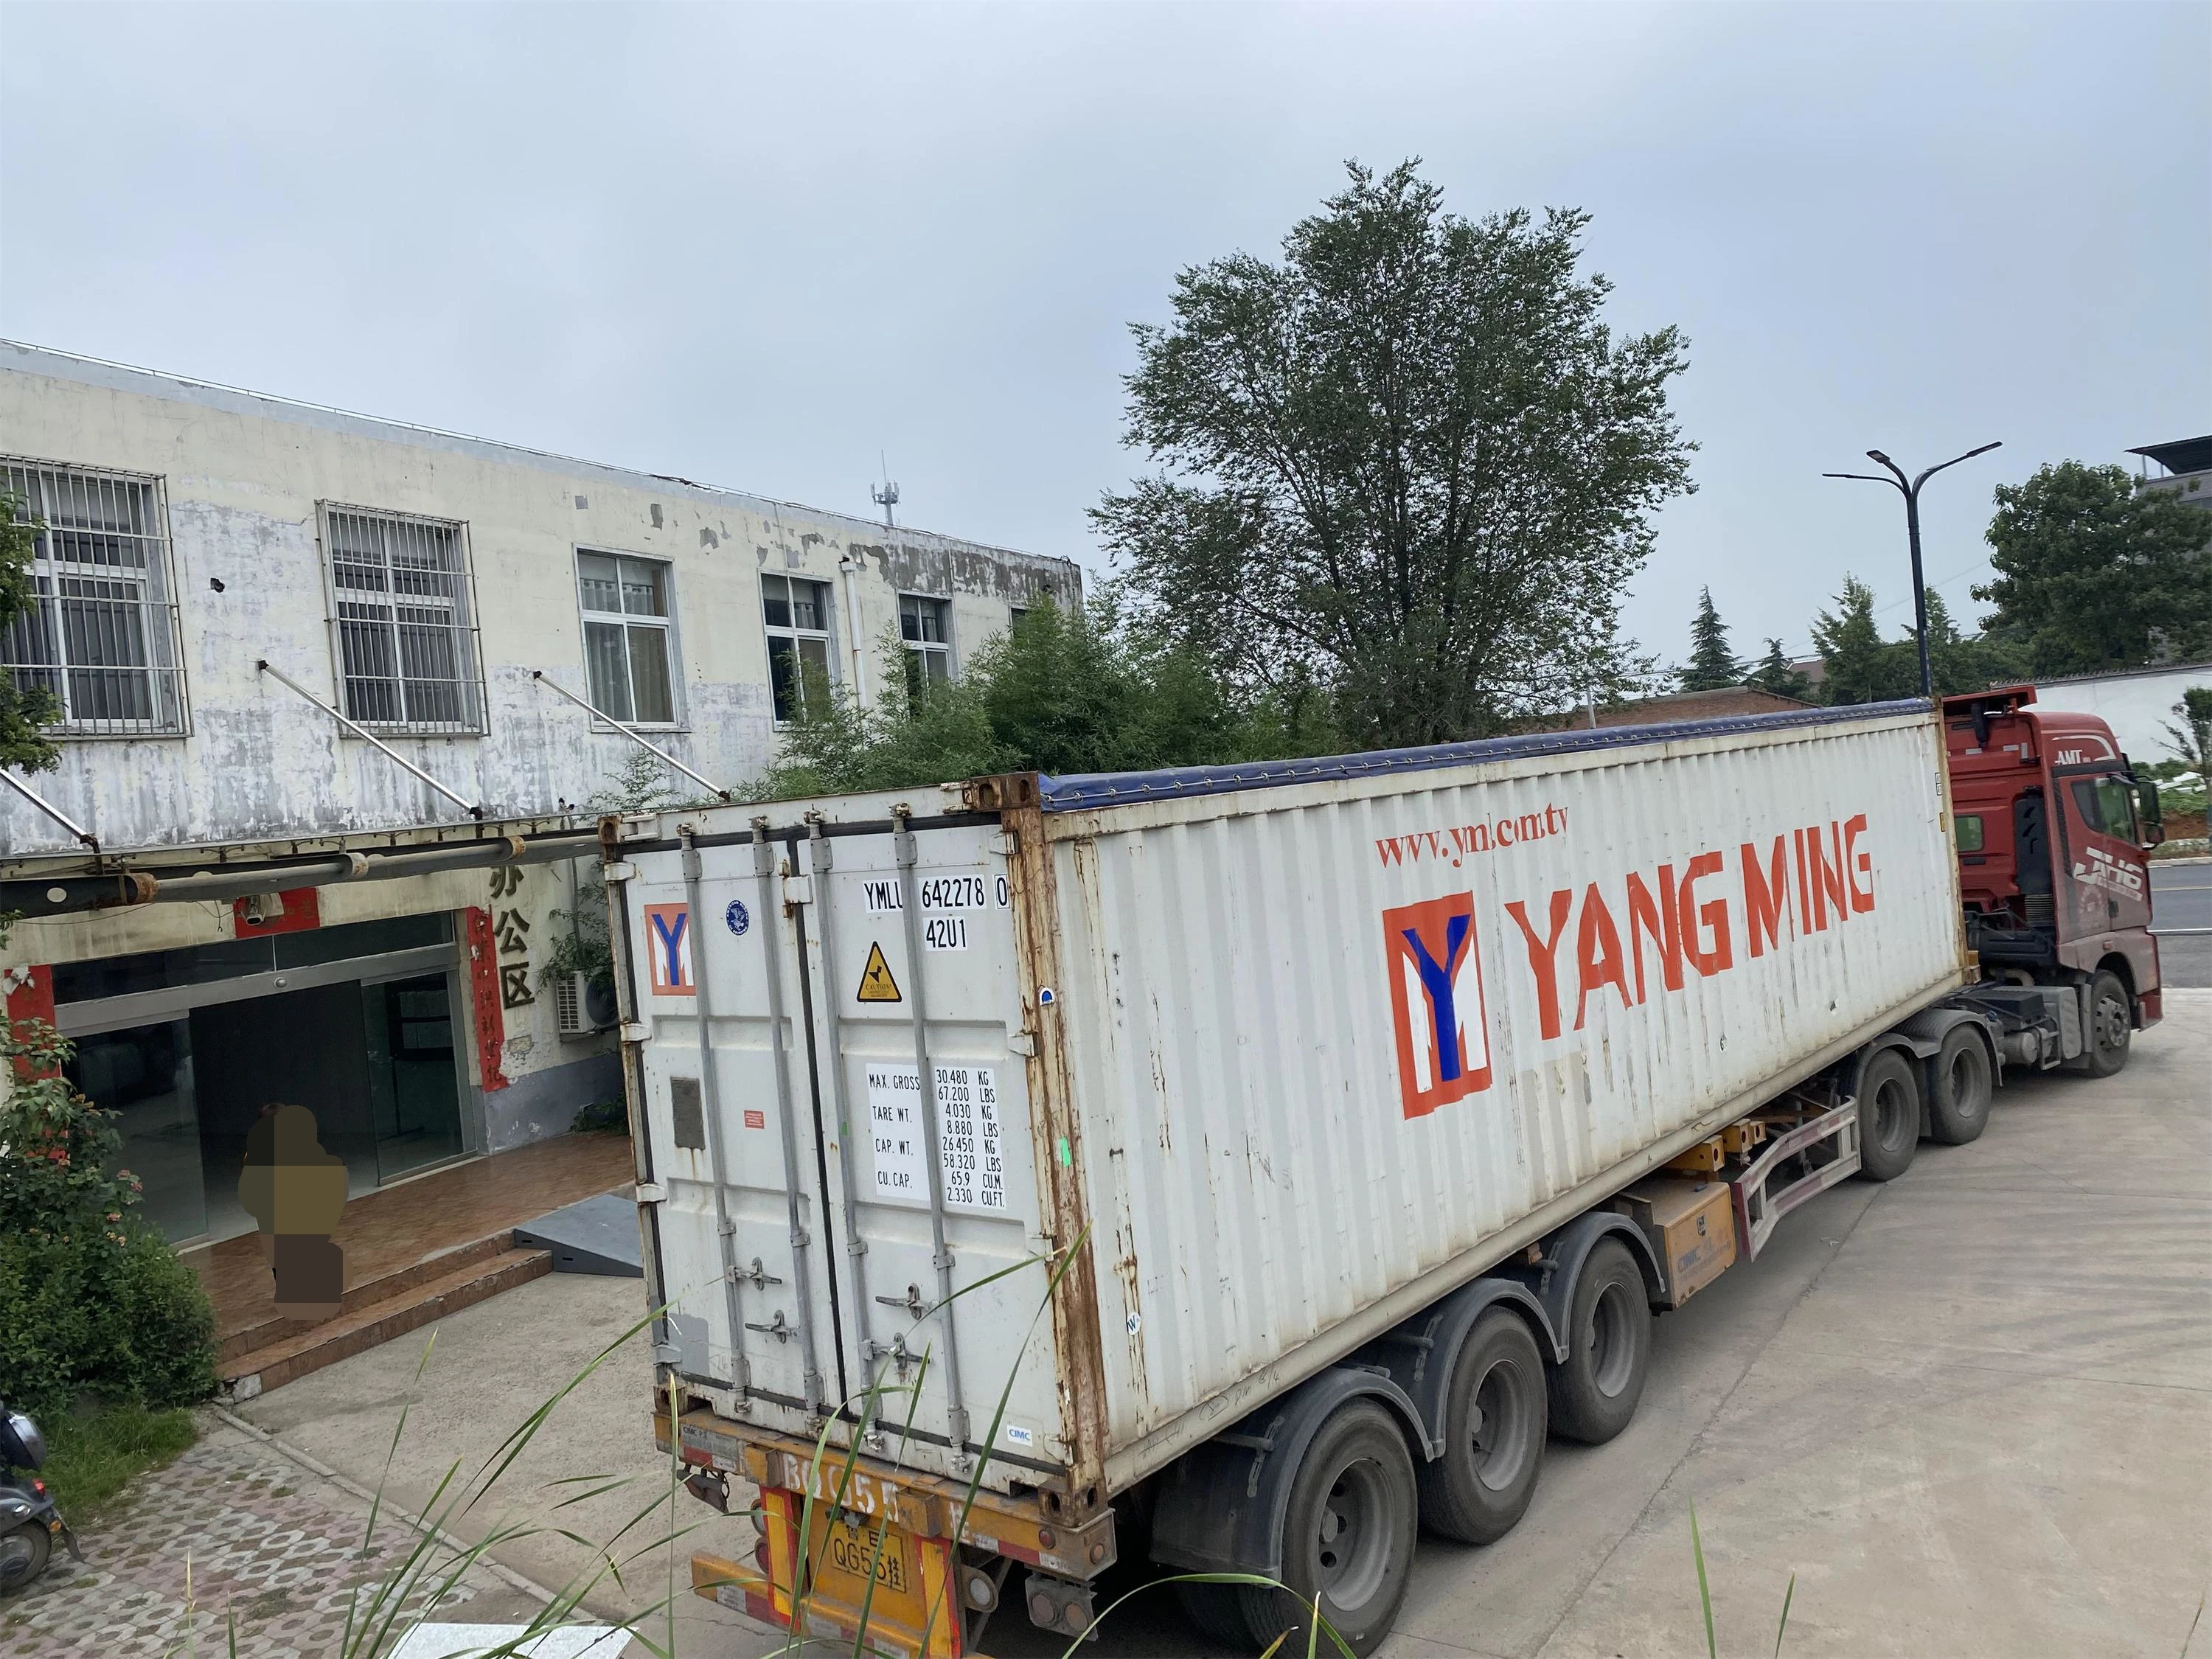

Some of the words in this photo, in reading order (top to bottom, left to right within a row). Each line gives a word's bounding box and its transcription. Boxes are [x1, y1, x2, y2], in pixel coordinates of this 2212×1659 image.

[863, 881, 904, 911] YMLU
[922, 877, 985, 908] 642278
[925, 919, 967, 949] 42U1
[1504, 850, 1733, 1040] YANG
[1740, 813, 1876, 959] MING
[869, 1074, 890, 1089] MAX.
[893, 1075, 921, 1091] GROSS
[936, 1069, 968, 1085] 30.480
[977, 1071, 990, 1086] KG
[938, 1086, 970, 1102] 67.200
[979, 1088, 995, 1103] LBS
[872, 1105, 894, 1121] TARE
[897, 1107, 913, 1123] WT.
[945, 1103, 971, 1119] 4.030
[981, 1105, 992, 1120] KG
[947, 1120, 973, 1135] 8.880
[983, 1122, 999, 1138] LBS
[875, 1138, 895, 1154] CAP.
[899, 1141, 914, 1156] WT.
[942, 1136, 974, 1152] 26.450
[984, 1139, 996, 1155] KG
[943, 1153, 975, 1169] 58.320
[986, 1157, 1002, 1172] LBS
[951, 1171, 970, 1186] 65.9
[947, 1187, 973, 1203] 2.330
[1009, 1428, 1031, 1441] CIMC
